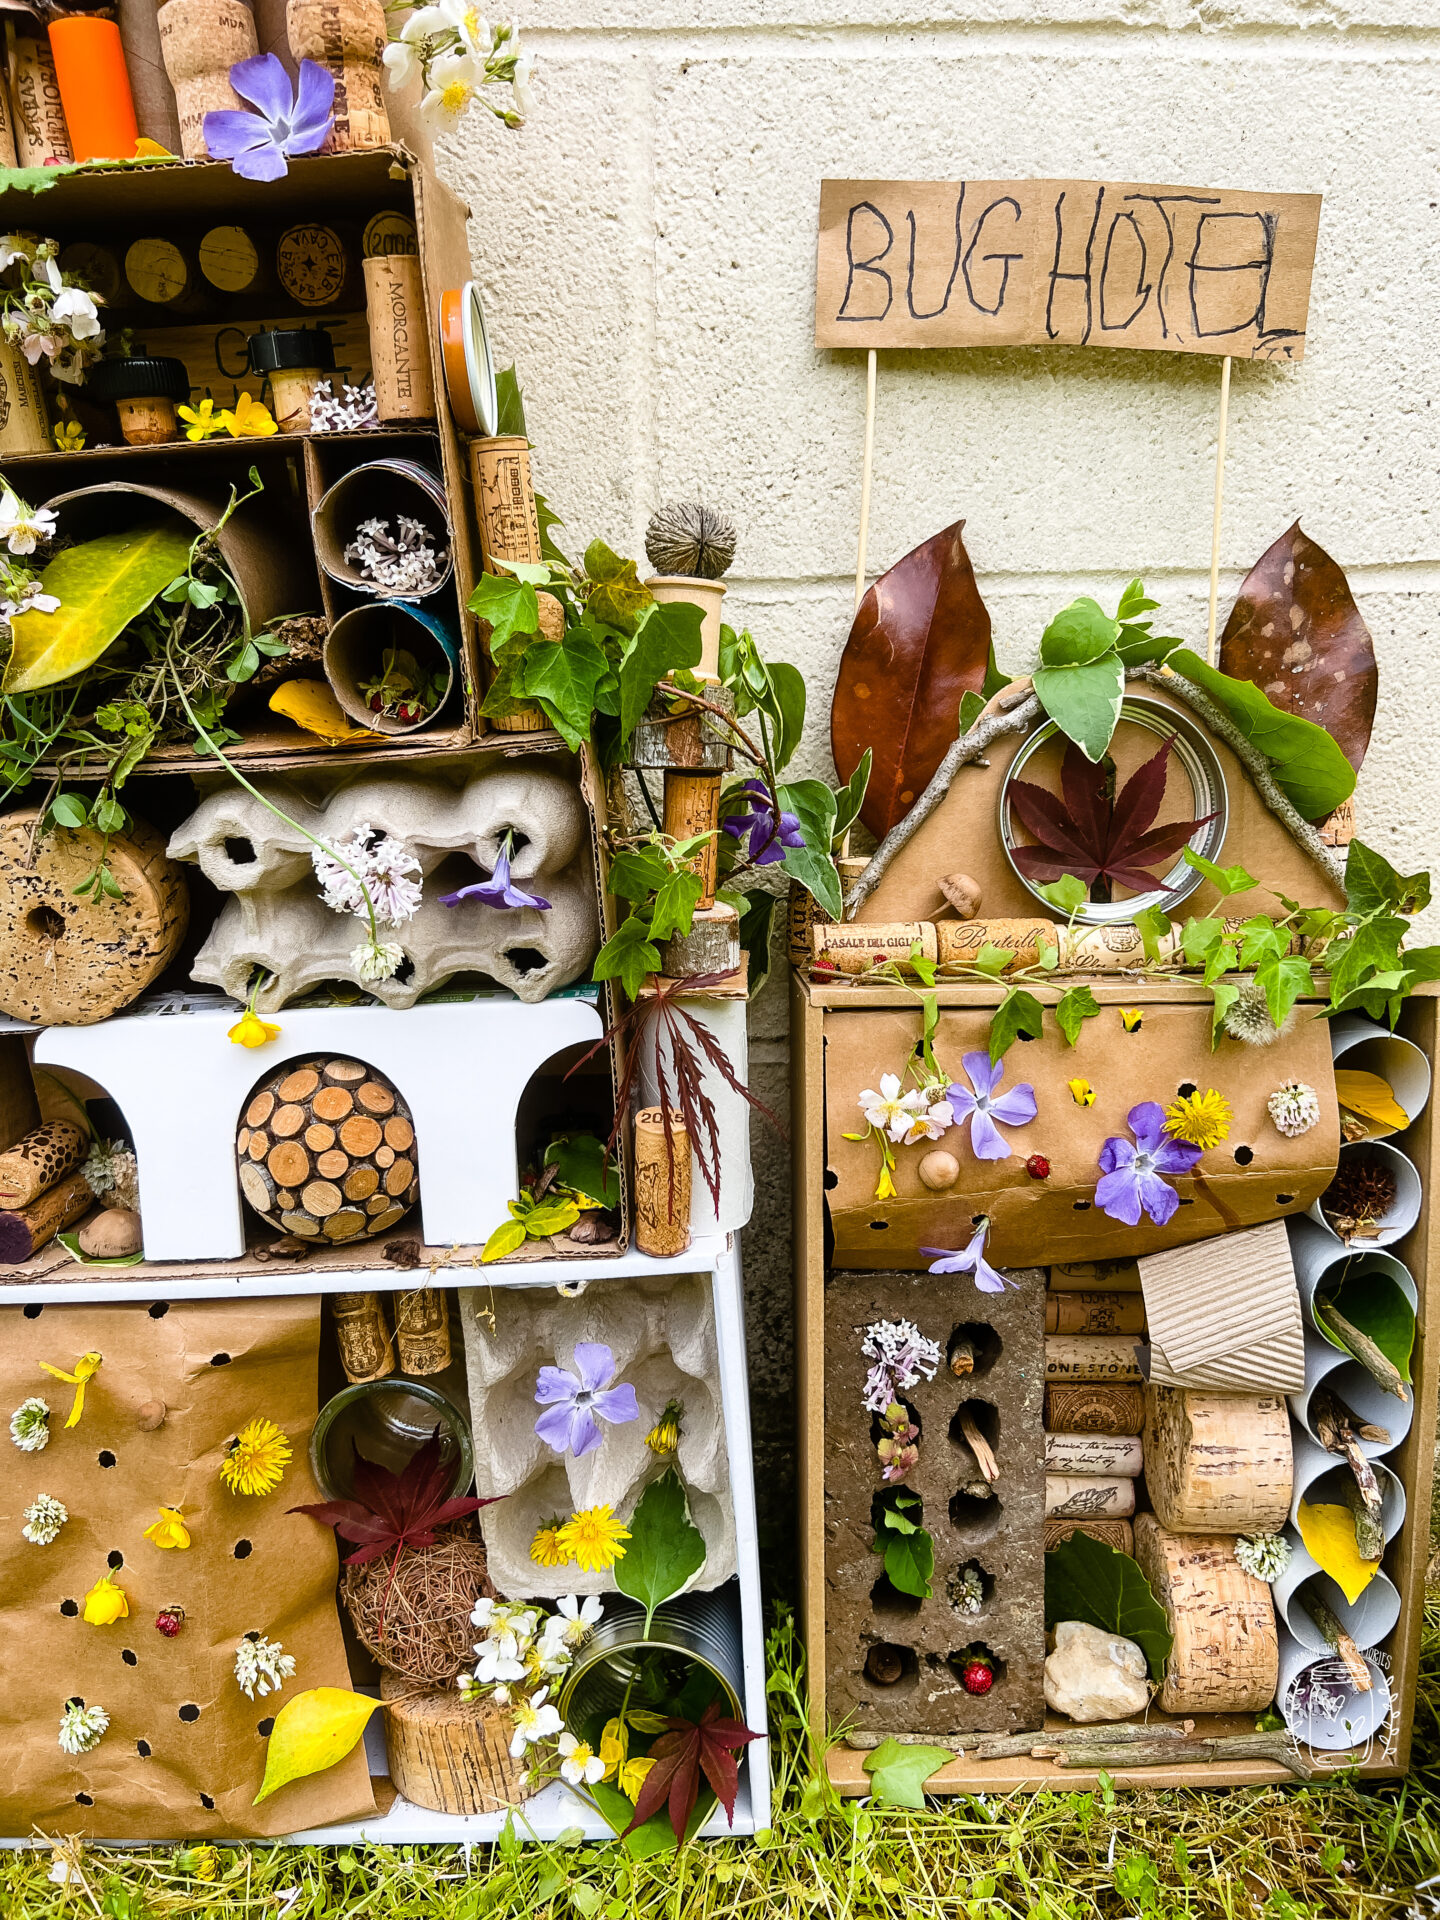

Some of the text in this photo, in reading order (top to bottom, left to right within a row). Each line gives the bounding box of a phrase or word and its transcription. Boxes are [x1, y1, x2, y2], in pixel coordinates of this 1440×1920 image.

[835, 180, 1306, 345] BUG HOTEL
[389, 281, 413, 399] MORGANTE
[824, 938, 865, 949] CASALE
[867, 937, 886, 948] DEL
[640, 1111, 685, 1124] 205
[1047, 1362, 1141, 1375] ONE STONE
